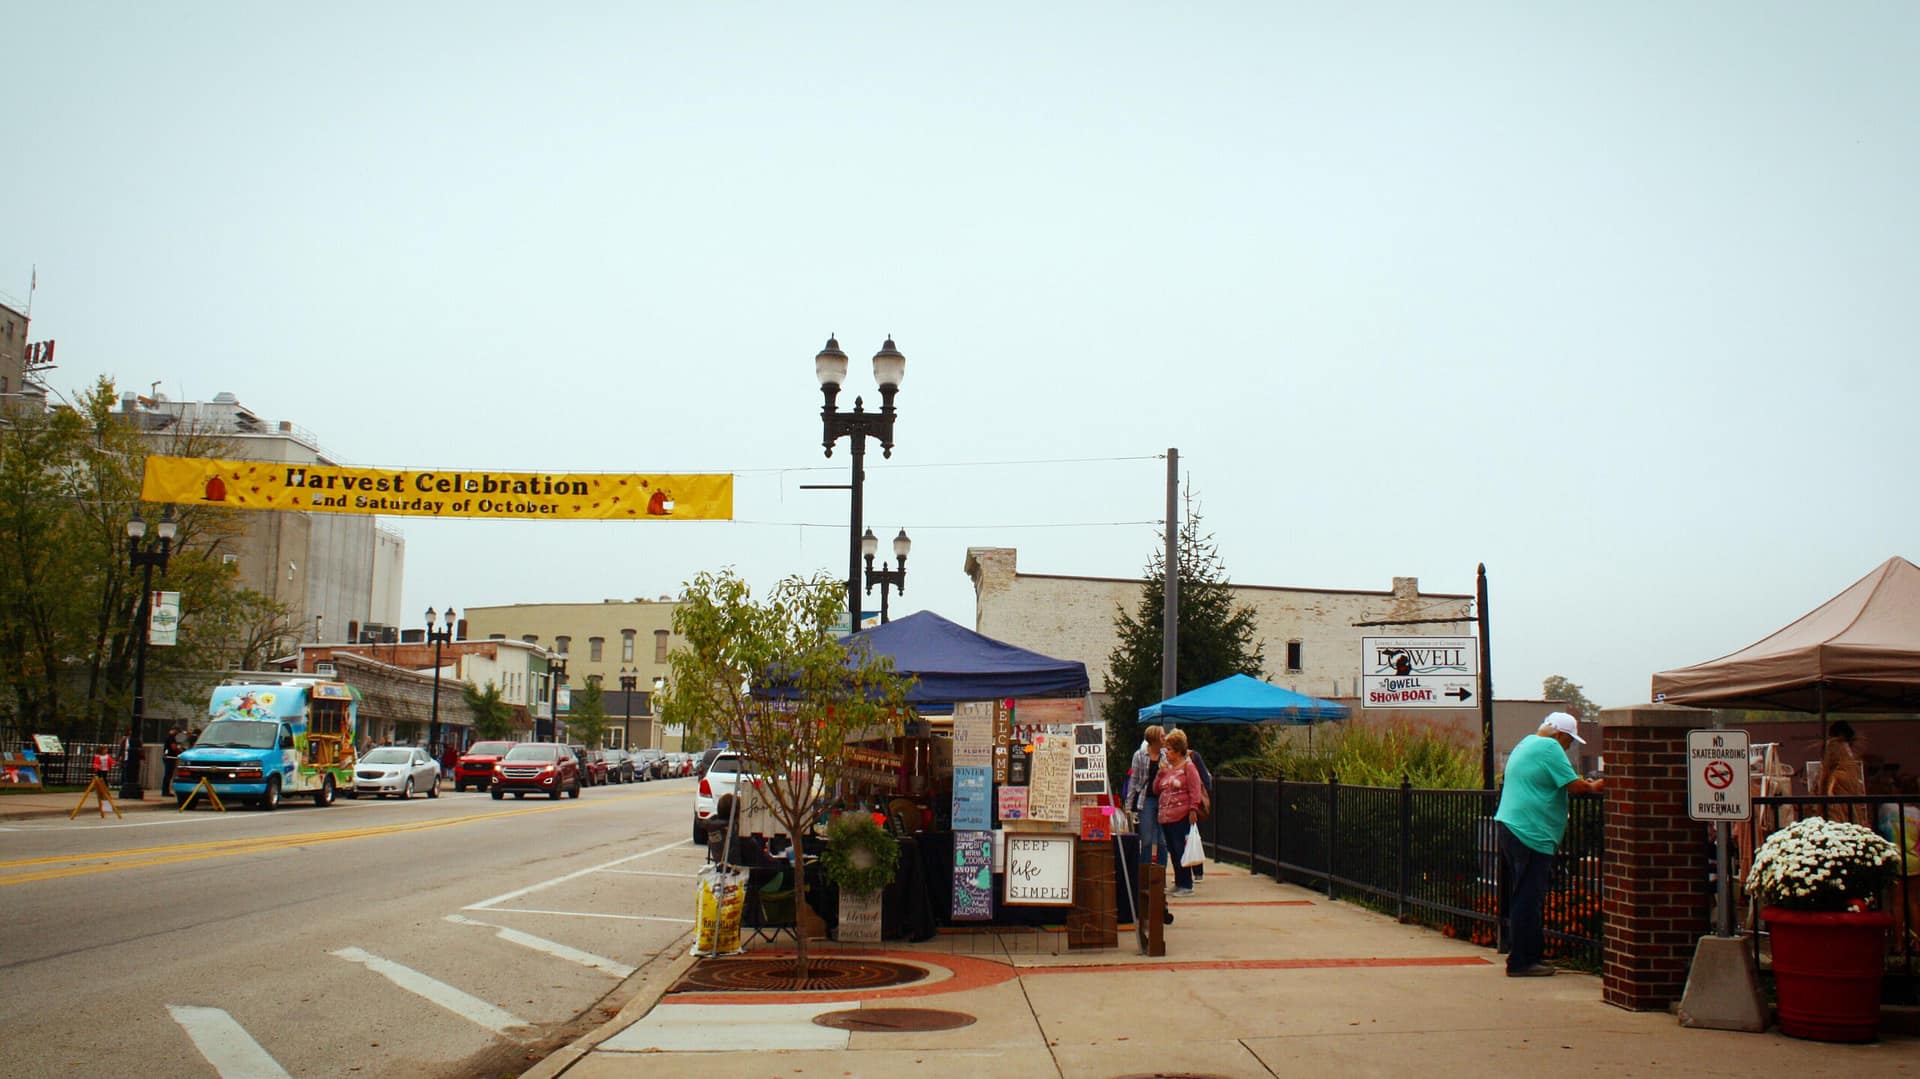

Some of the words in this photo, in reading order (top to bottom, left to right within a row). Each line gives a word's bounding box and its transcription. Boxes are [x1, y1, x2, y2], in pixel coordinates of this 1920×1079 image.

[285, 467, 404, 493] Harvest
[415, 473, 588, 495] Celebration
[312, 493, 347, 507] 2nd
[355, 495, 444, 514] Saturday
[452, 499, 471, 512] of
[478, 499, 559, 514] October
[1377, 648, 1466, 669] LOWELL
[1384, 677, 1421, 692] LOWELL
[1712, 736, 1724, 747] NO
[1077, 745, 1101, 755] OLD
[1692, 748, 1746, 759] SKATEBOARDING
[1714, 792, 1725, 802] ON
[1698, 803, 1741, 814] RIVERWALK
[1013, 839, 1050, 851] KEEP
[1011, 859, 1042, 881] life
[1010, 886, 1070, 899] SIMPLE
